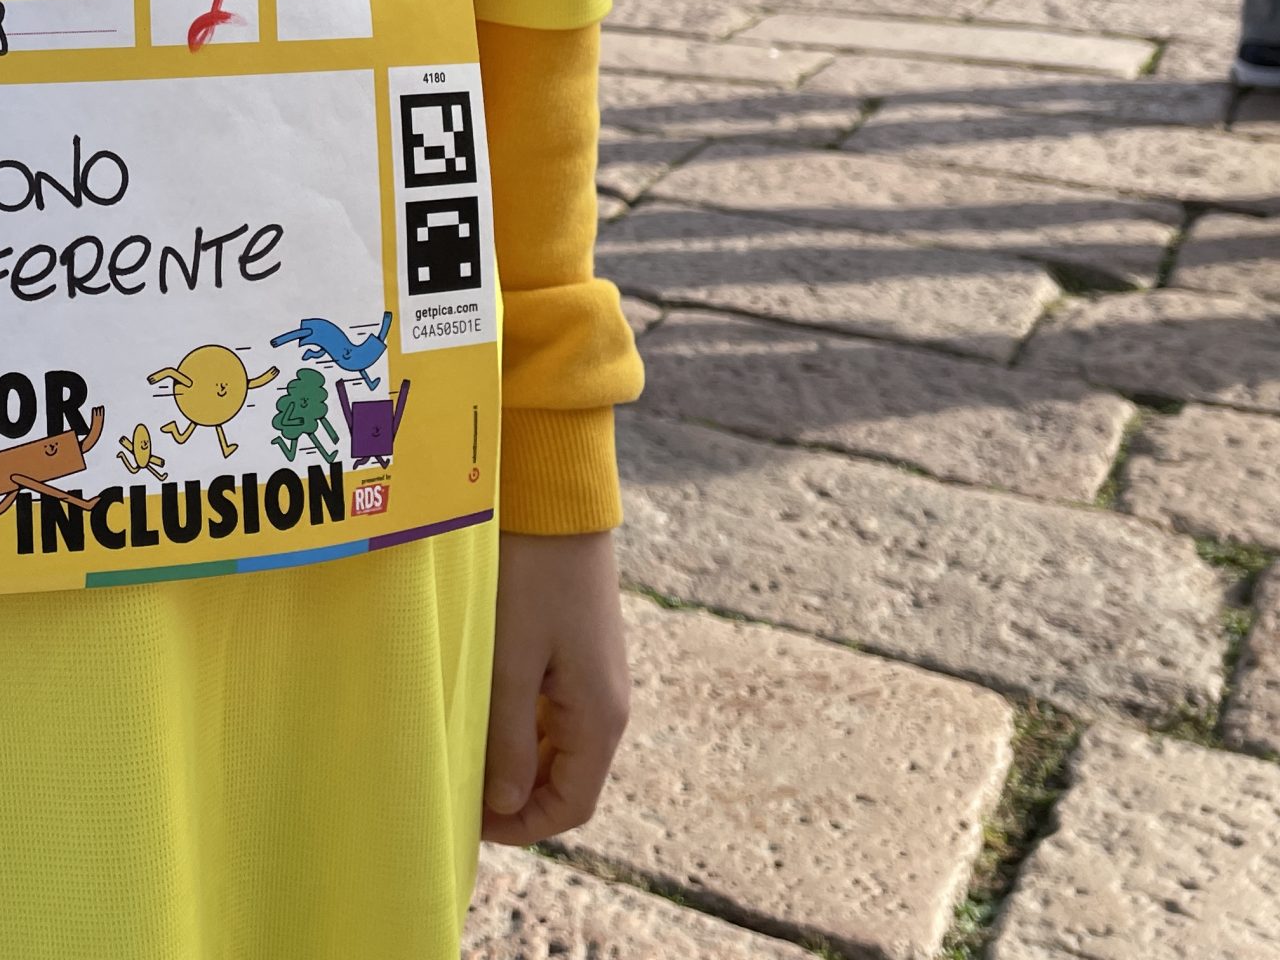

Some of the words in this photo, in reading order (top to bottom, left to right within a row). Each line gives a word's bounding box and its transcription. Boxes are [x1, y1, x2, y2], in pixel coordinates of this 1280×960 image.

[422, 72, 446, 84] 4180
[415, 302, 478, 321] getpica.com
[412, 318, 482, 339] C4A505D1E
[16, 462, 345, 555] INCLUSION
[355, 485, 382, 511] RDS
